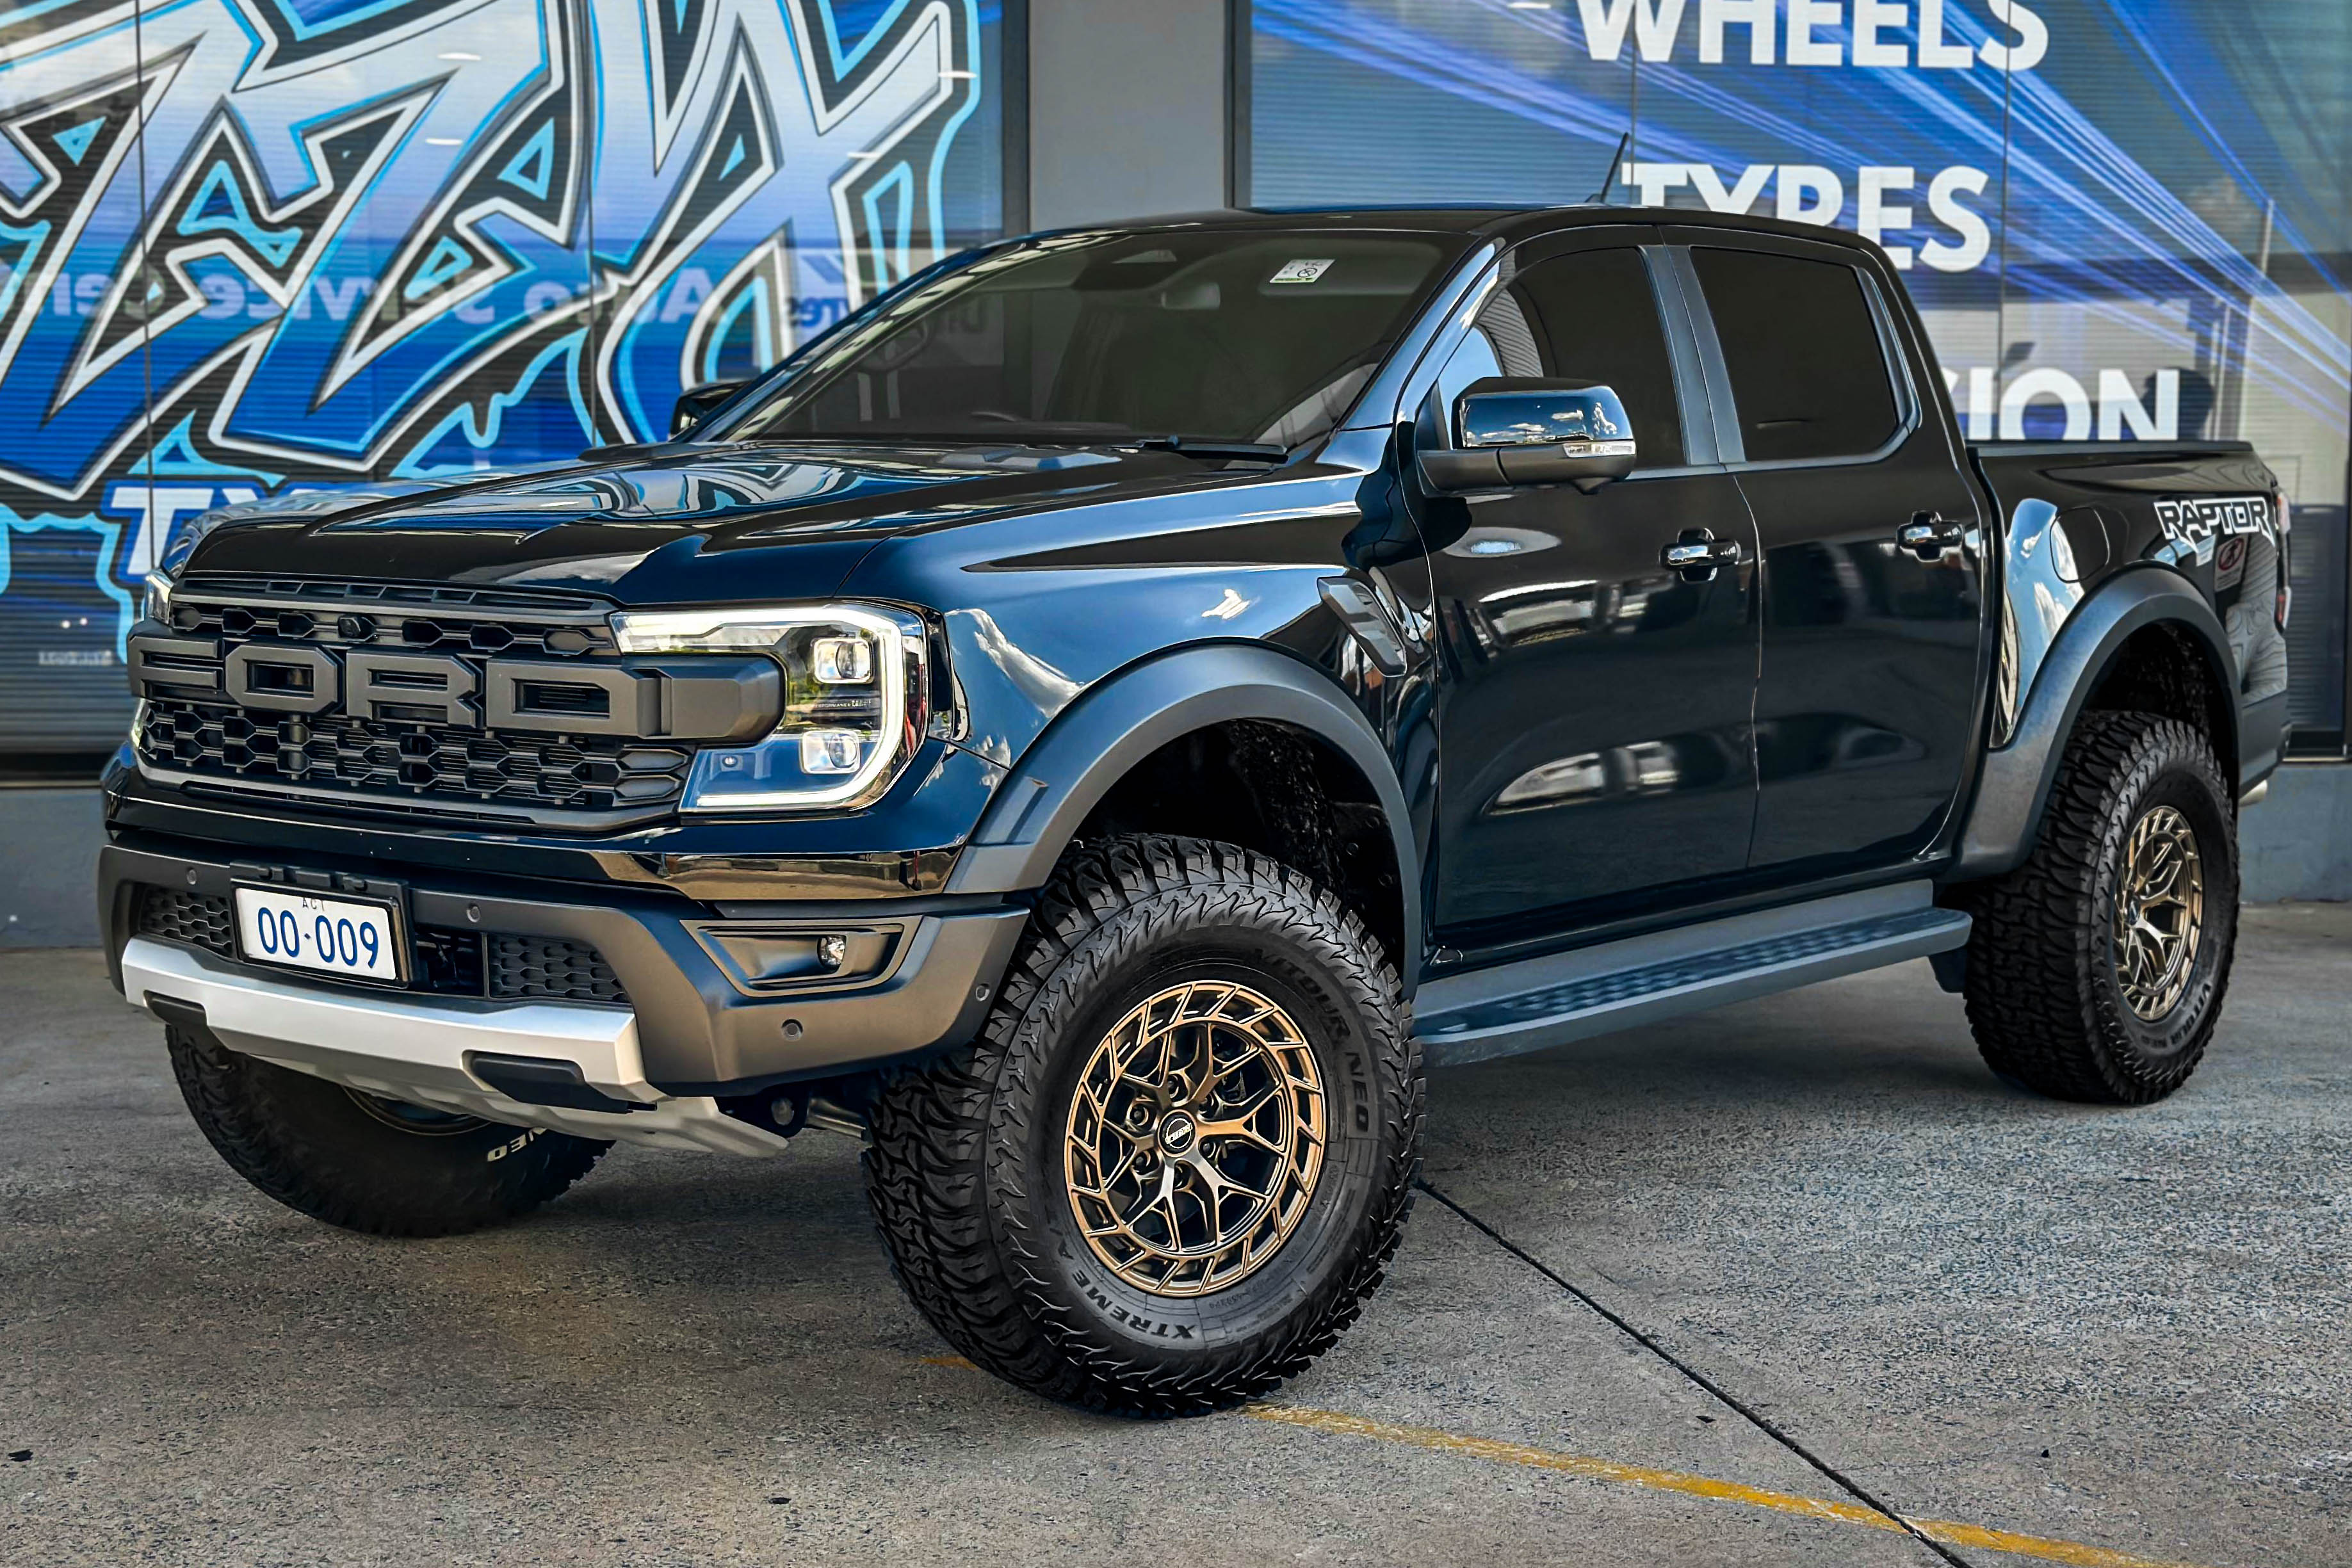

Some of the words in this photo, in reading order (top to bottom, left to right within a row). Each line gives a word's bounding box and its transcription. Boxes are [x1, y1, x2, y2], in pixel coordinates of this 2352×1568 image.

[1576, 0, 2048, 71] WHEELS
[1942, 367, 2179, 440] ION
[2153, 497, 2275, 553] RAPTOR
[130, 635, 642, 739] FORD
[1345, 1052, 1369, 1132] NEO
[1072, 1270, 1197, 1339] XTREME
